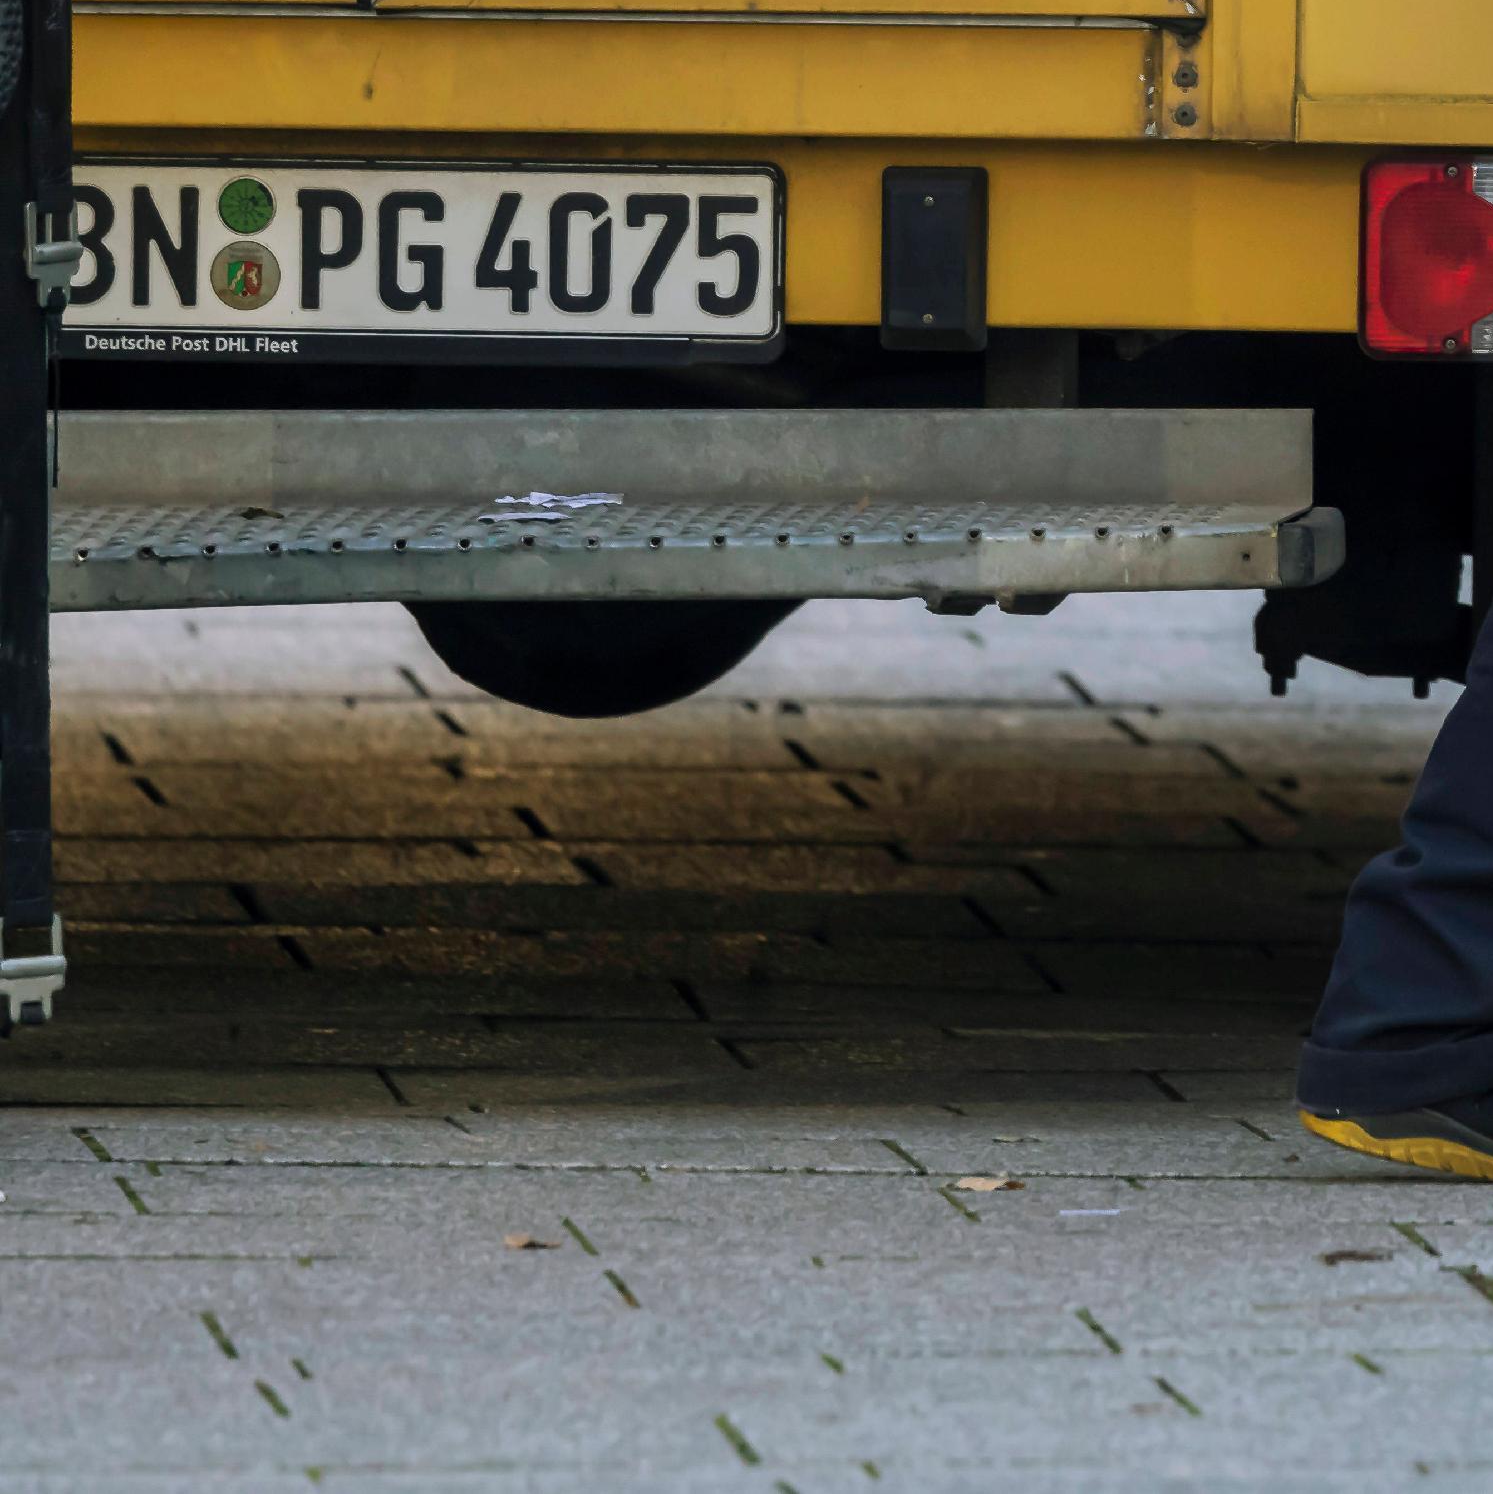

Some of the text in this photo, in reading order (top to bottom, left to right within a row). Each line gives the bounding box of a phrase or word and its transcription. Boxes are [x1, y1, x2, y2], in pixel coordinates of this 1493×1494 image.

[297, 188, 445, 312] PG
[475, 191, 760, 317] 4075
[85, 334, 299, 354] Deutsche Post DHL Fleet
